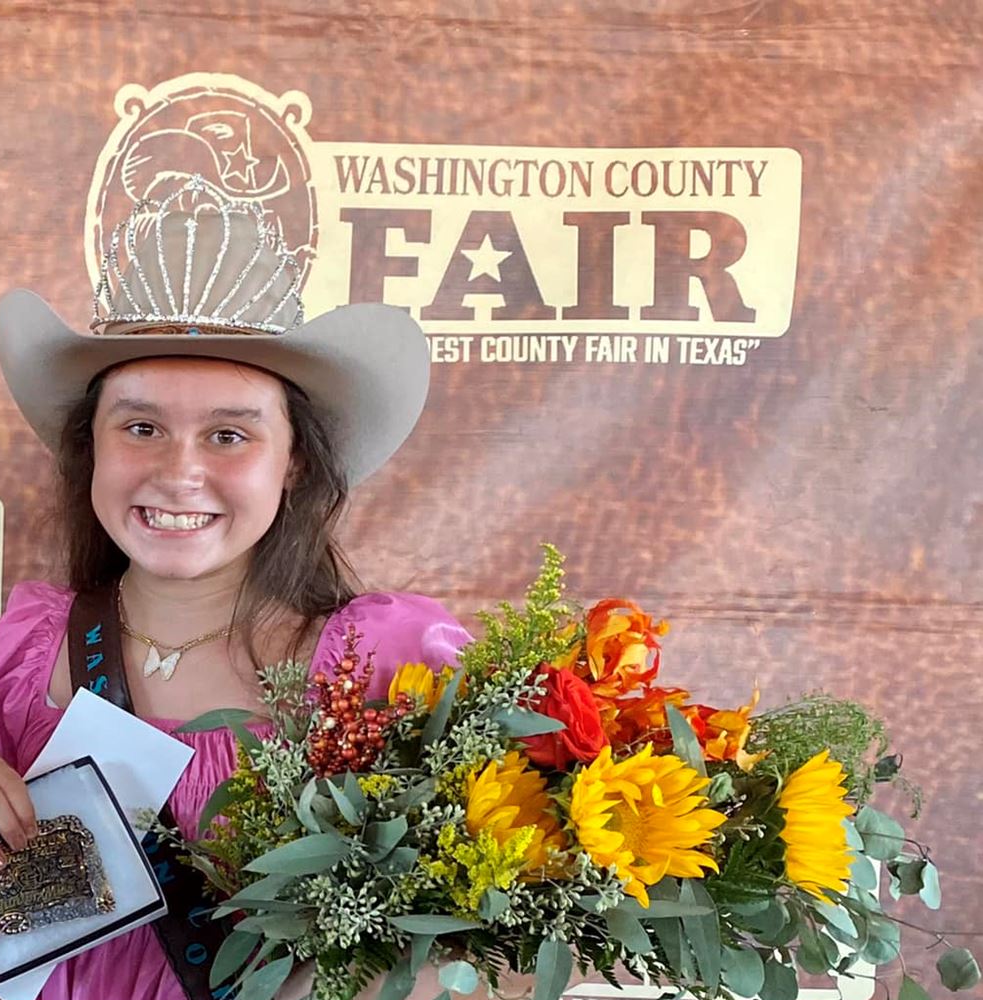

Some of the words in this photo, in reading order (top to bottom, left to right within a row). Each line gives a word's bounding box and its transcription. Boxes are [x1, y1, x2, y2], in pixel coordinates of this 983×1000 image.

[333, 154, 594, 198] WASHINGTON
[604, 158, 769, 198] COUNTY
[336, 206, 757, 323] FAIR
[426, 336, 474, 363] EST
[480, 336, 578, 362] COUNTY
[585, 335, 638, 363] FAIR
[644, 336, 670, 364] IN
